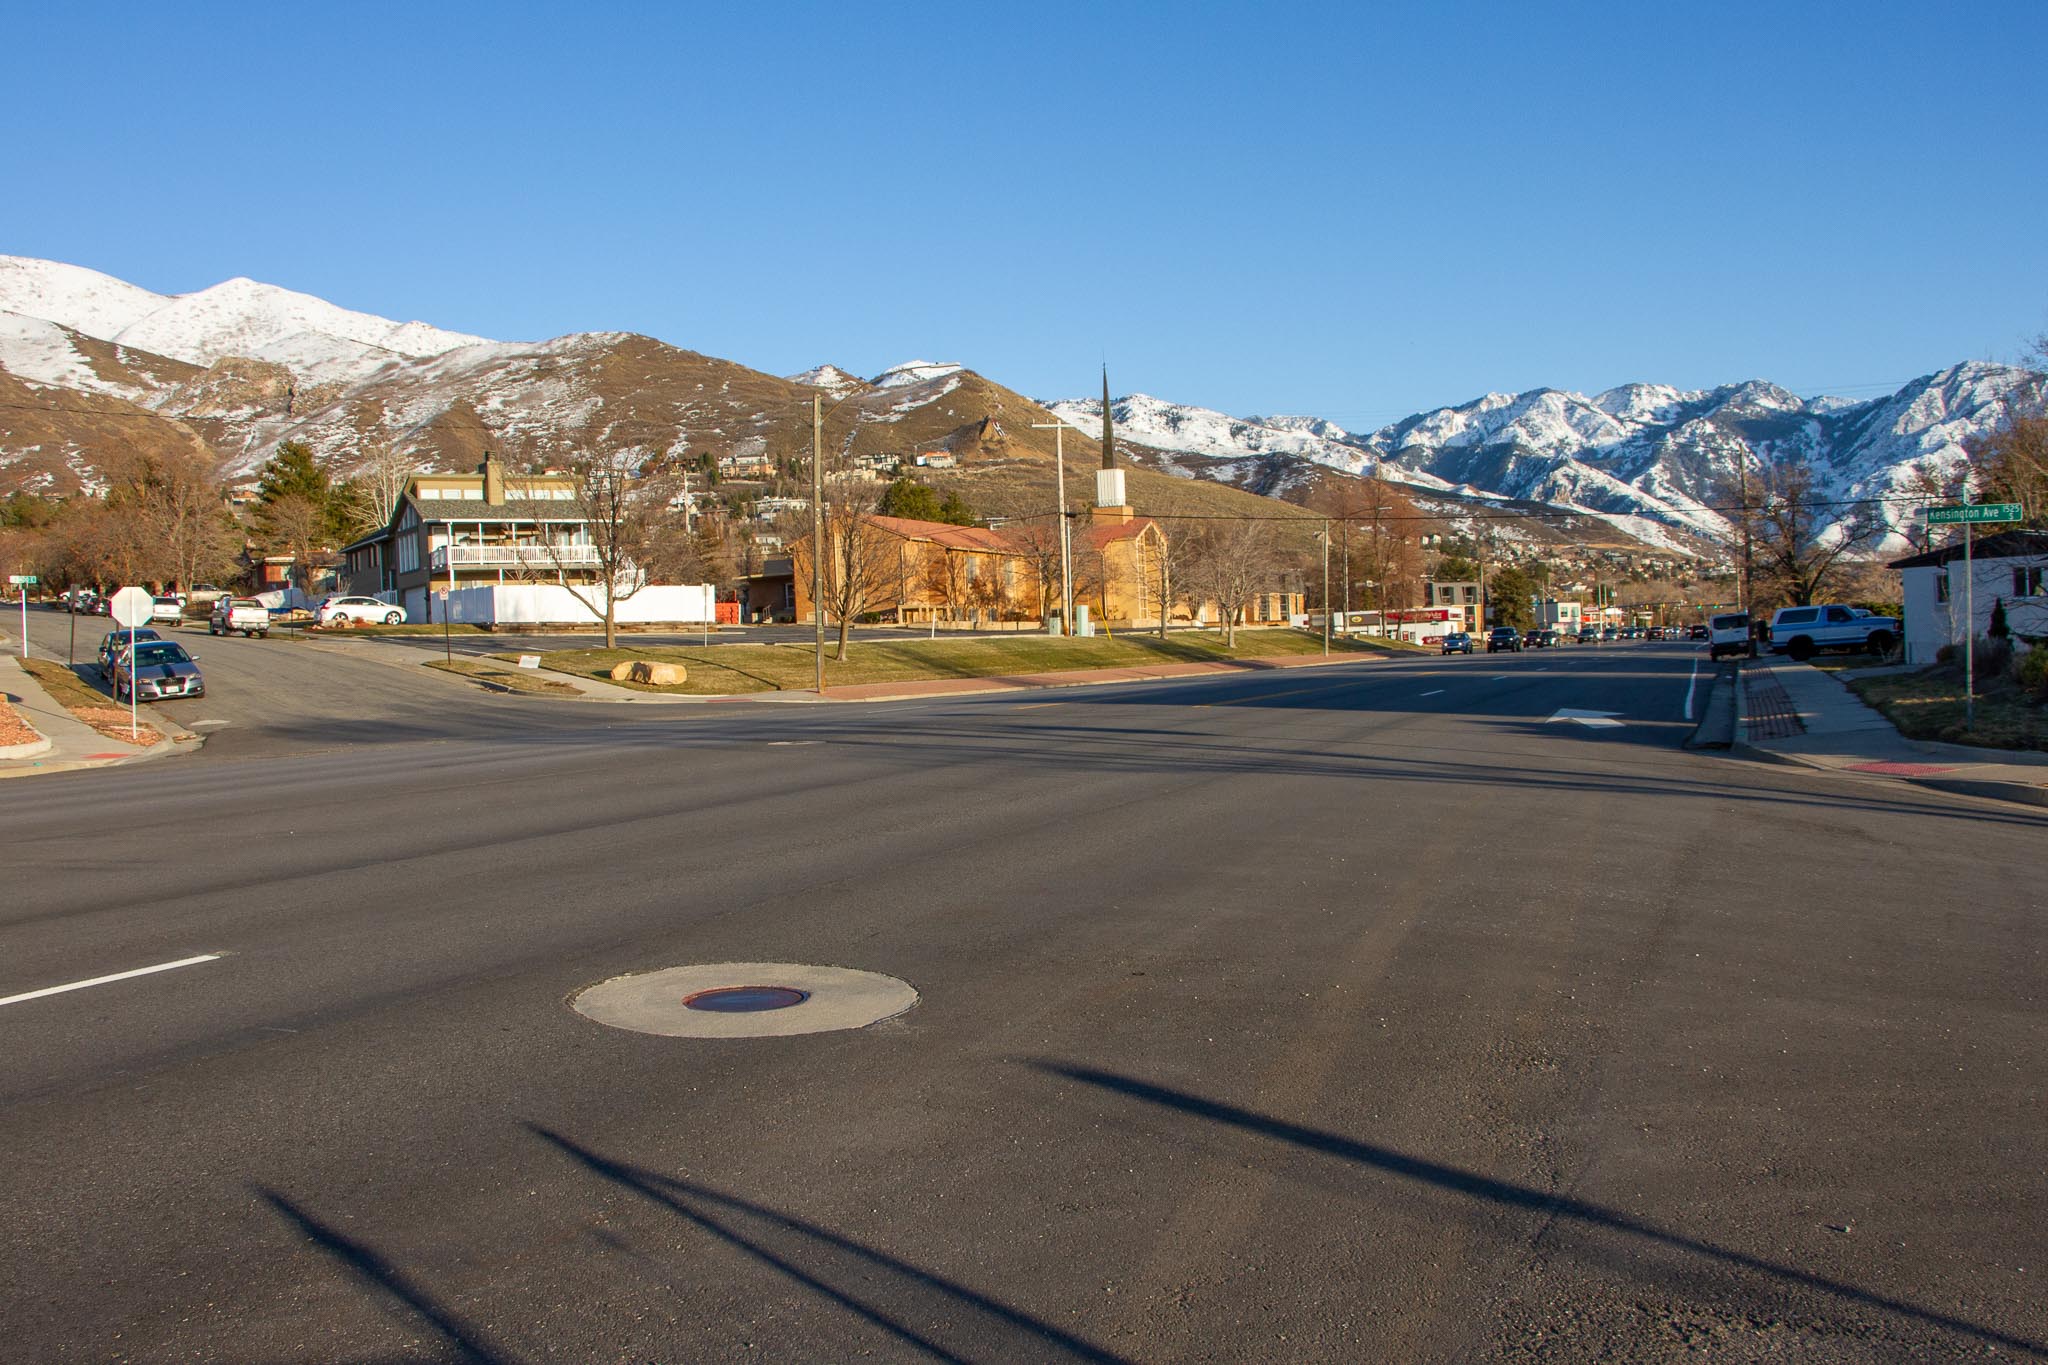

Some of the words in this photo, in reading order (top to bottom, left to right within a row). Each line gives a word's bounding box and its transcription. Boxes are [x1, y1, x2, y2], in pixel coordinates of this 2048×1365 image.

[1930, 508, 1979, 521] Kensington
[1983, 507, 1999, 518] Ave
[2009, 512, 2014, 520] S
